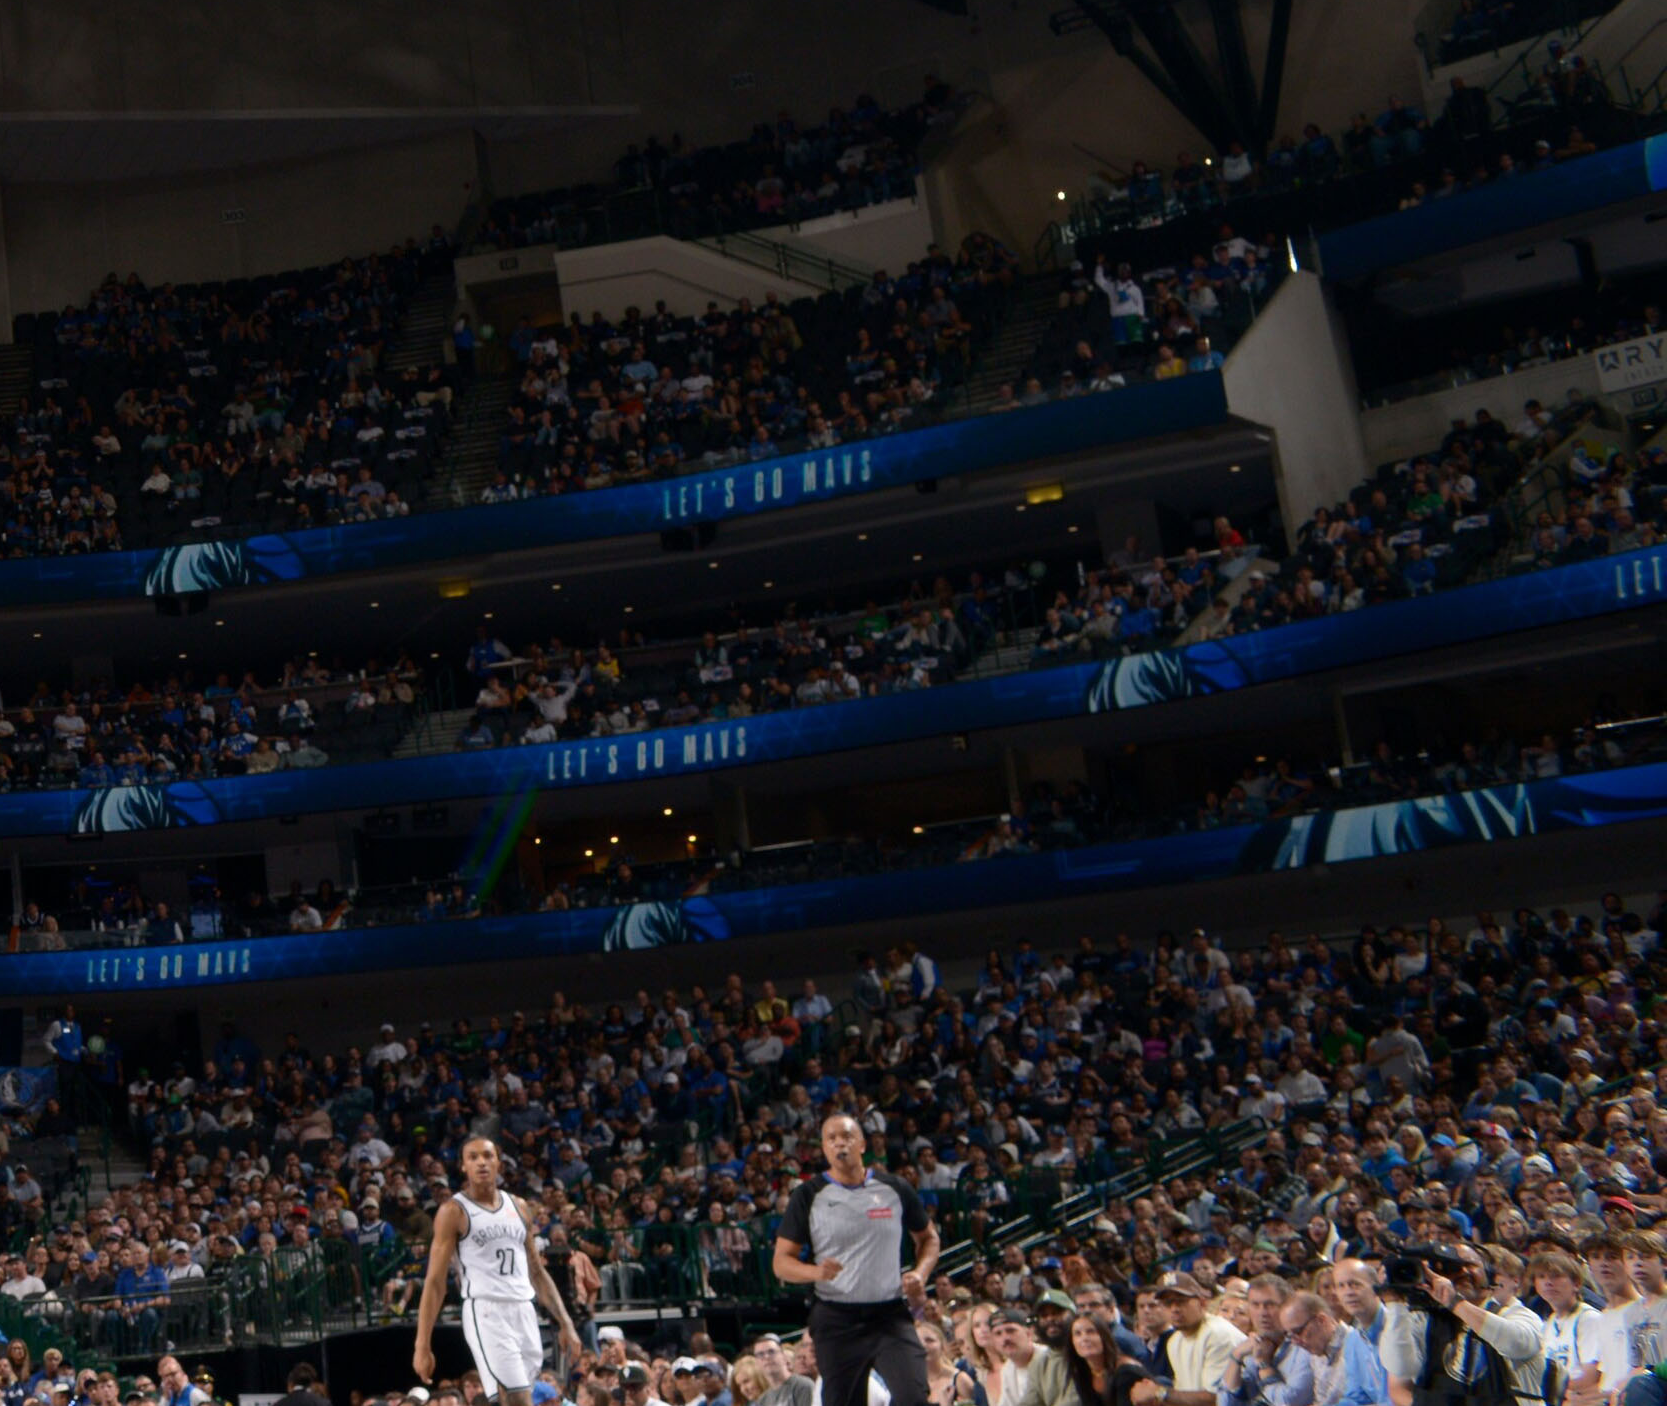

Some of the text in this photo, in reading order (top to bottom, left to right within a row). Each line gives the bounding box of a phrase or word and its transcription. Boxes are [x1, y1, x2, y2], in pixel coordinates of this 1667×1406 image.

[665, 450, 871, 519] LET'S GO MAVS
[548, 726, 746, 780] LET'S GO MAVS
[496, 1249, 514, 1275] 27
